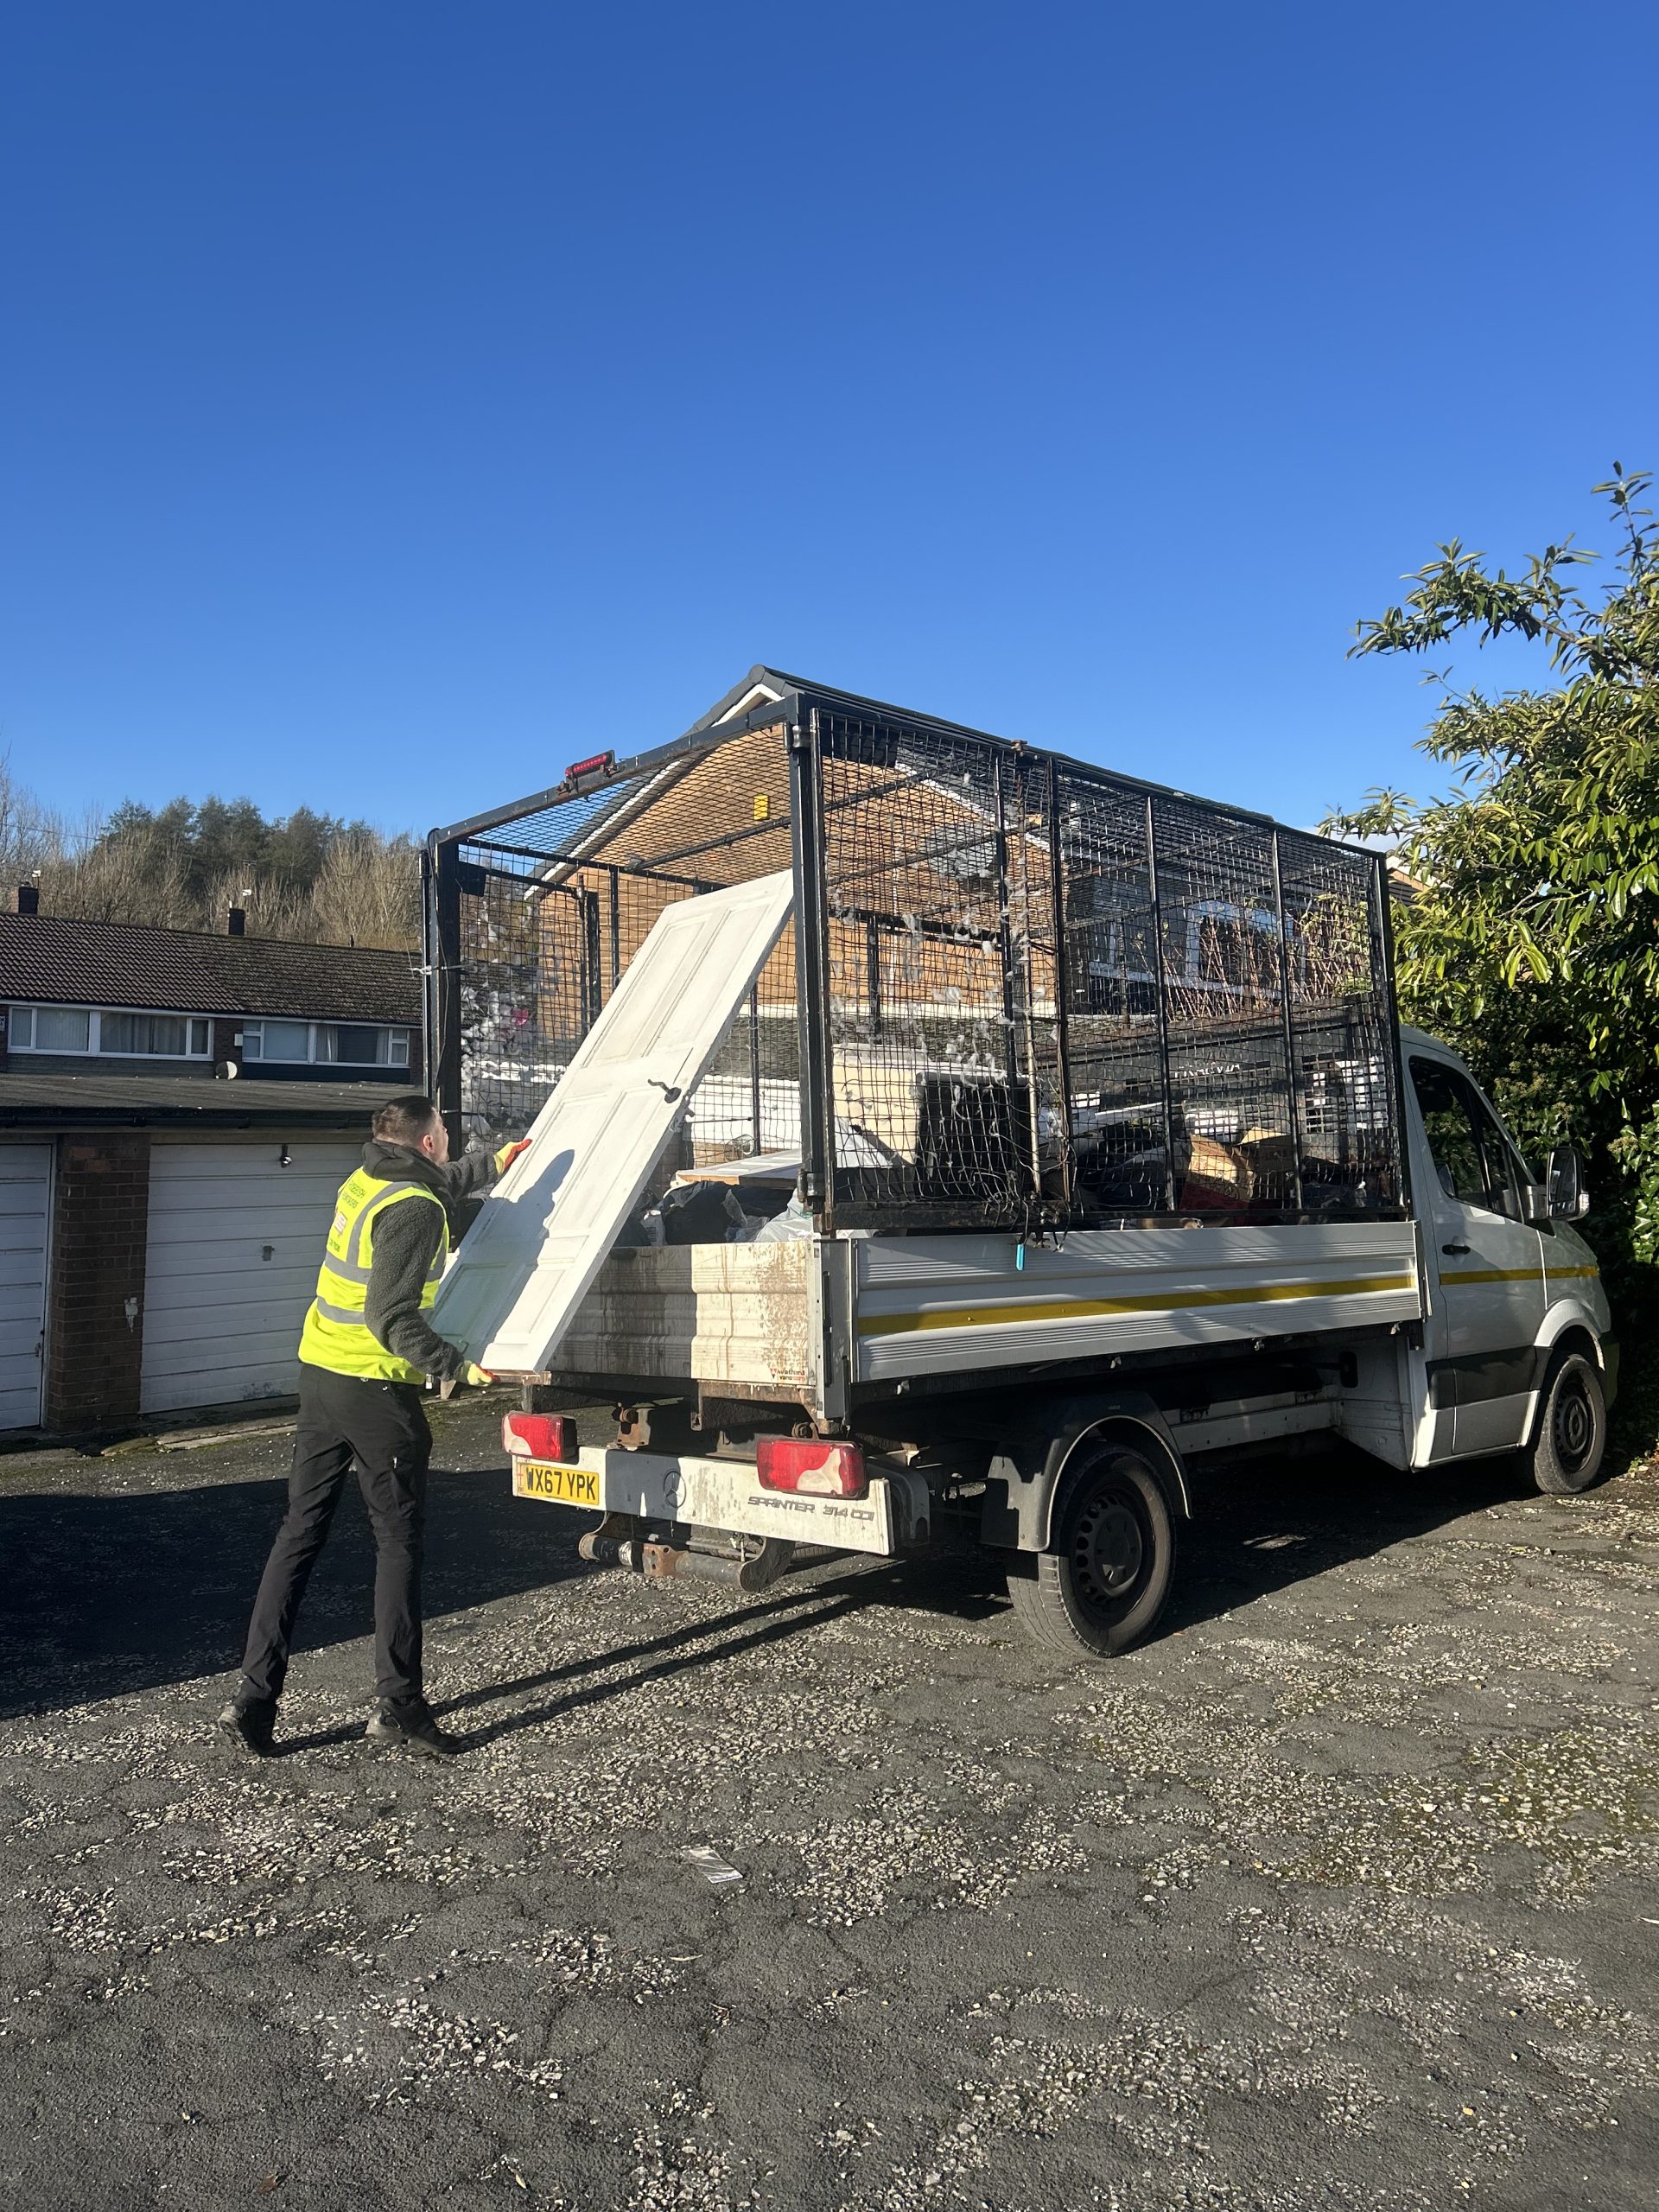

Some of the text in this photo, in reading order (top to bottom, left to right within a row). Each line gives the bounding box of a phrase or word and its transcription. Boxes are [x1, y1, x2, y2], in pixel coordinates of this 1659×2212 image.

[526, 1467, 596, 1501] WX67 YPK
[747, 1496, 875, 1522] SPRINTER 314 CDI
